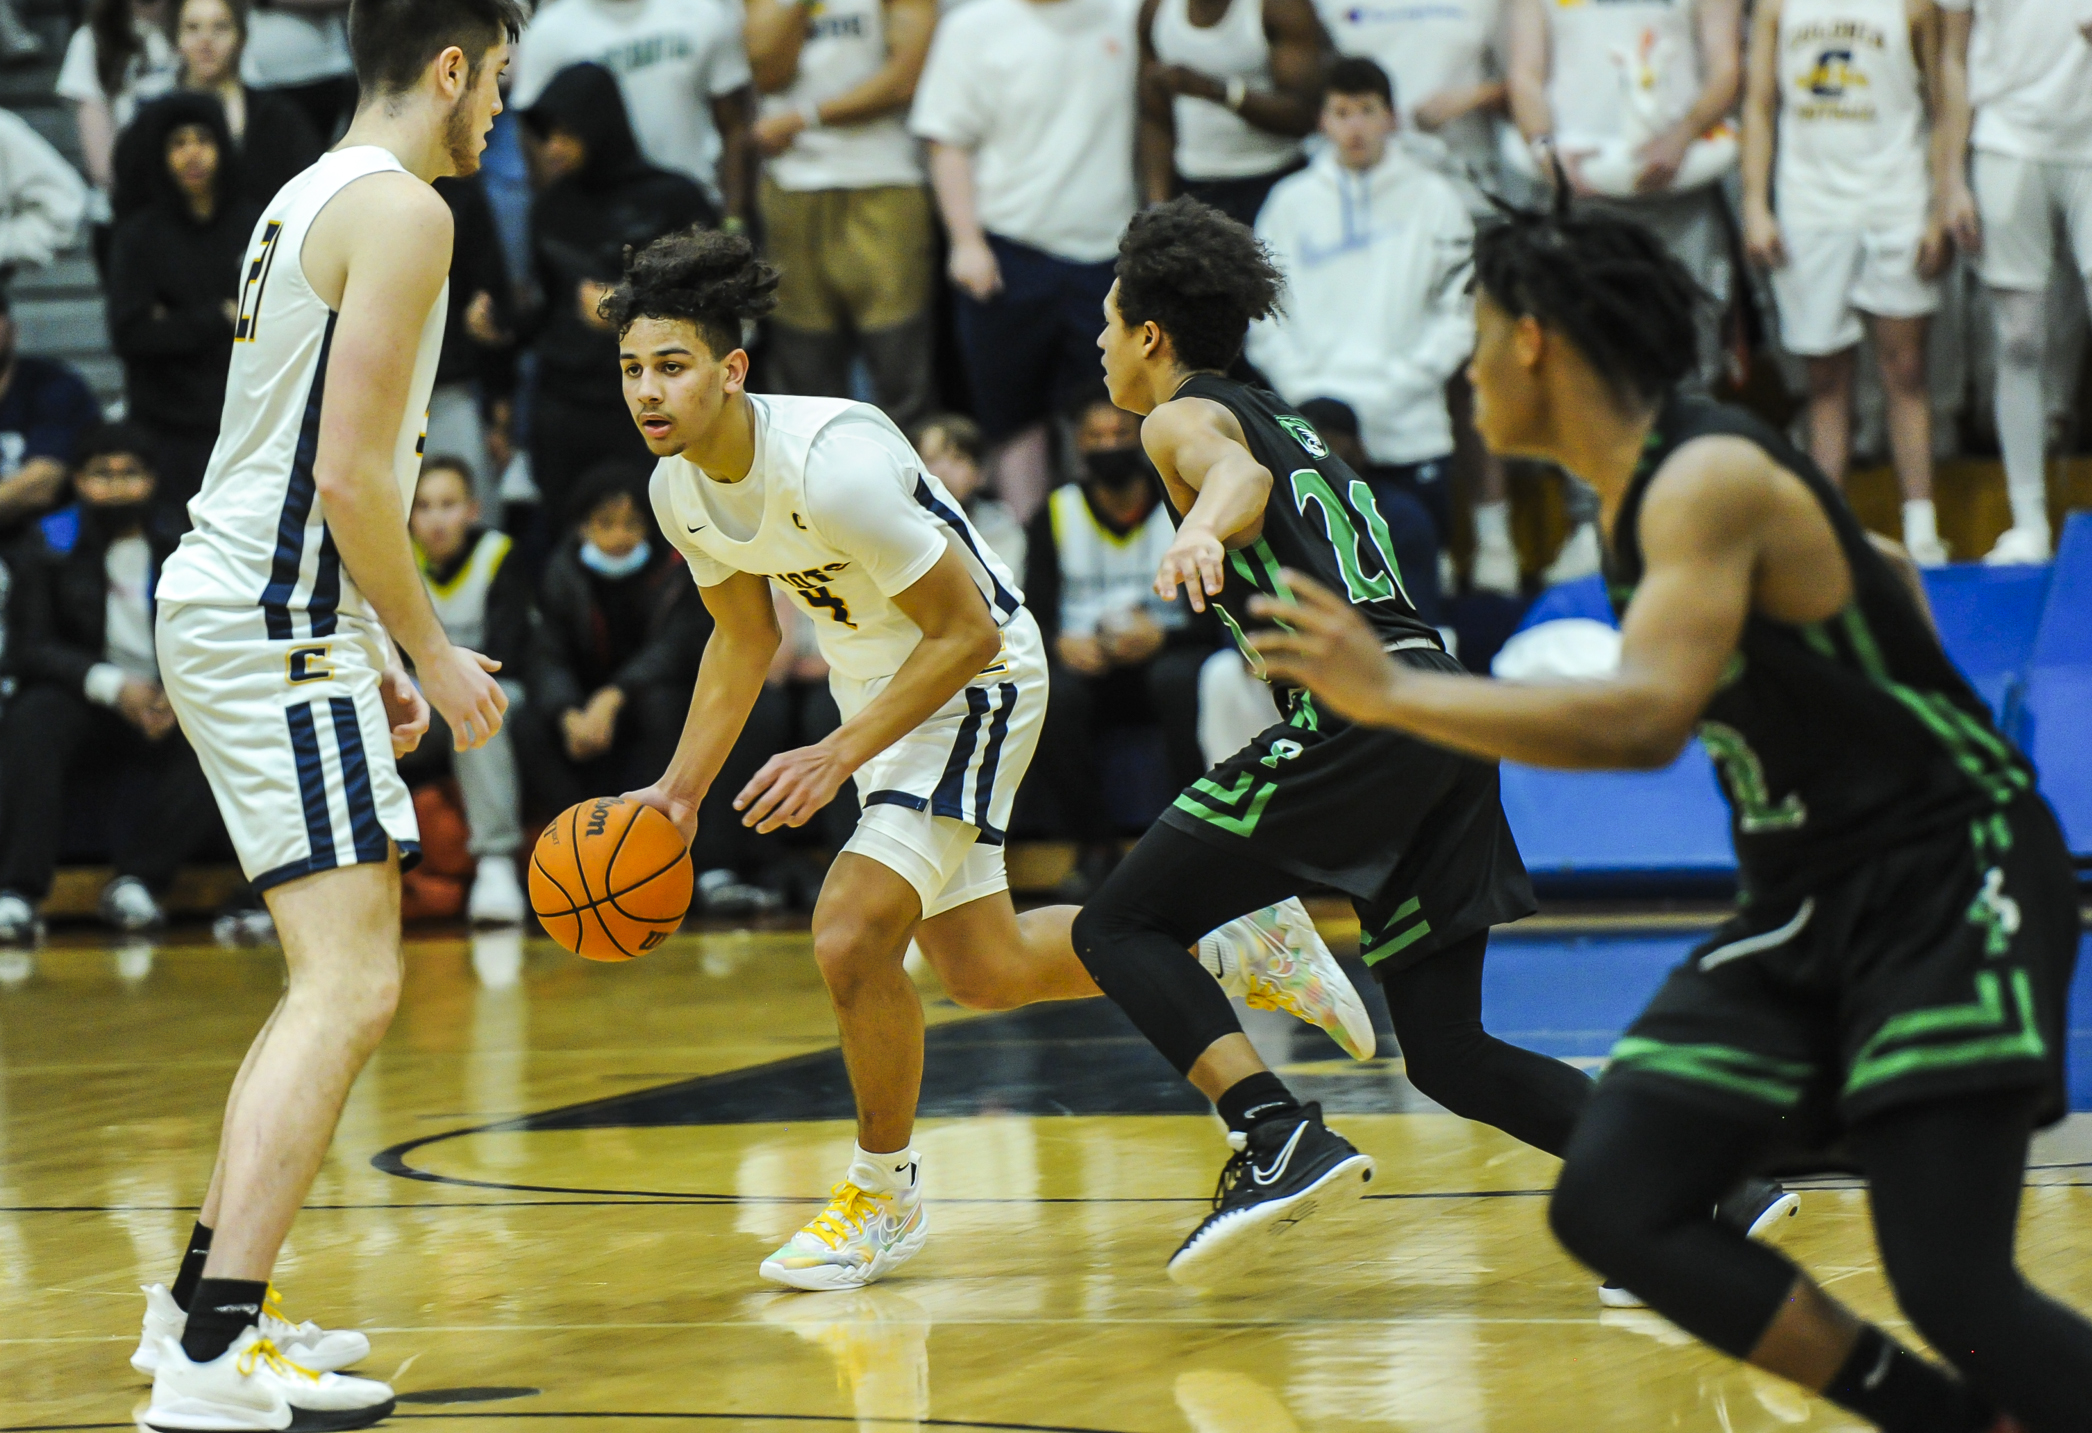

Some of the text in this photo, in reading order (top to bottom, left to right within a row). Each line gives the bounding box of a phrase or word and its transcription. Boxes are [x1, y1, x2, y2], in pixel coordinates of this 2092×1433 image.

[234, 220, 284, 342] 21
[797, 585, 858, 631] 4
[285, 644, 334, 686] C
[586, 797, 626, 837] lson
